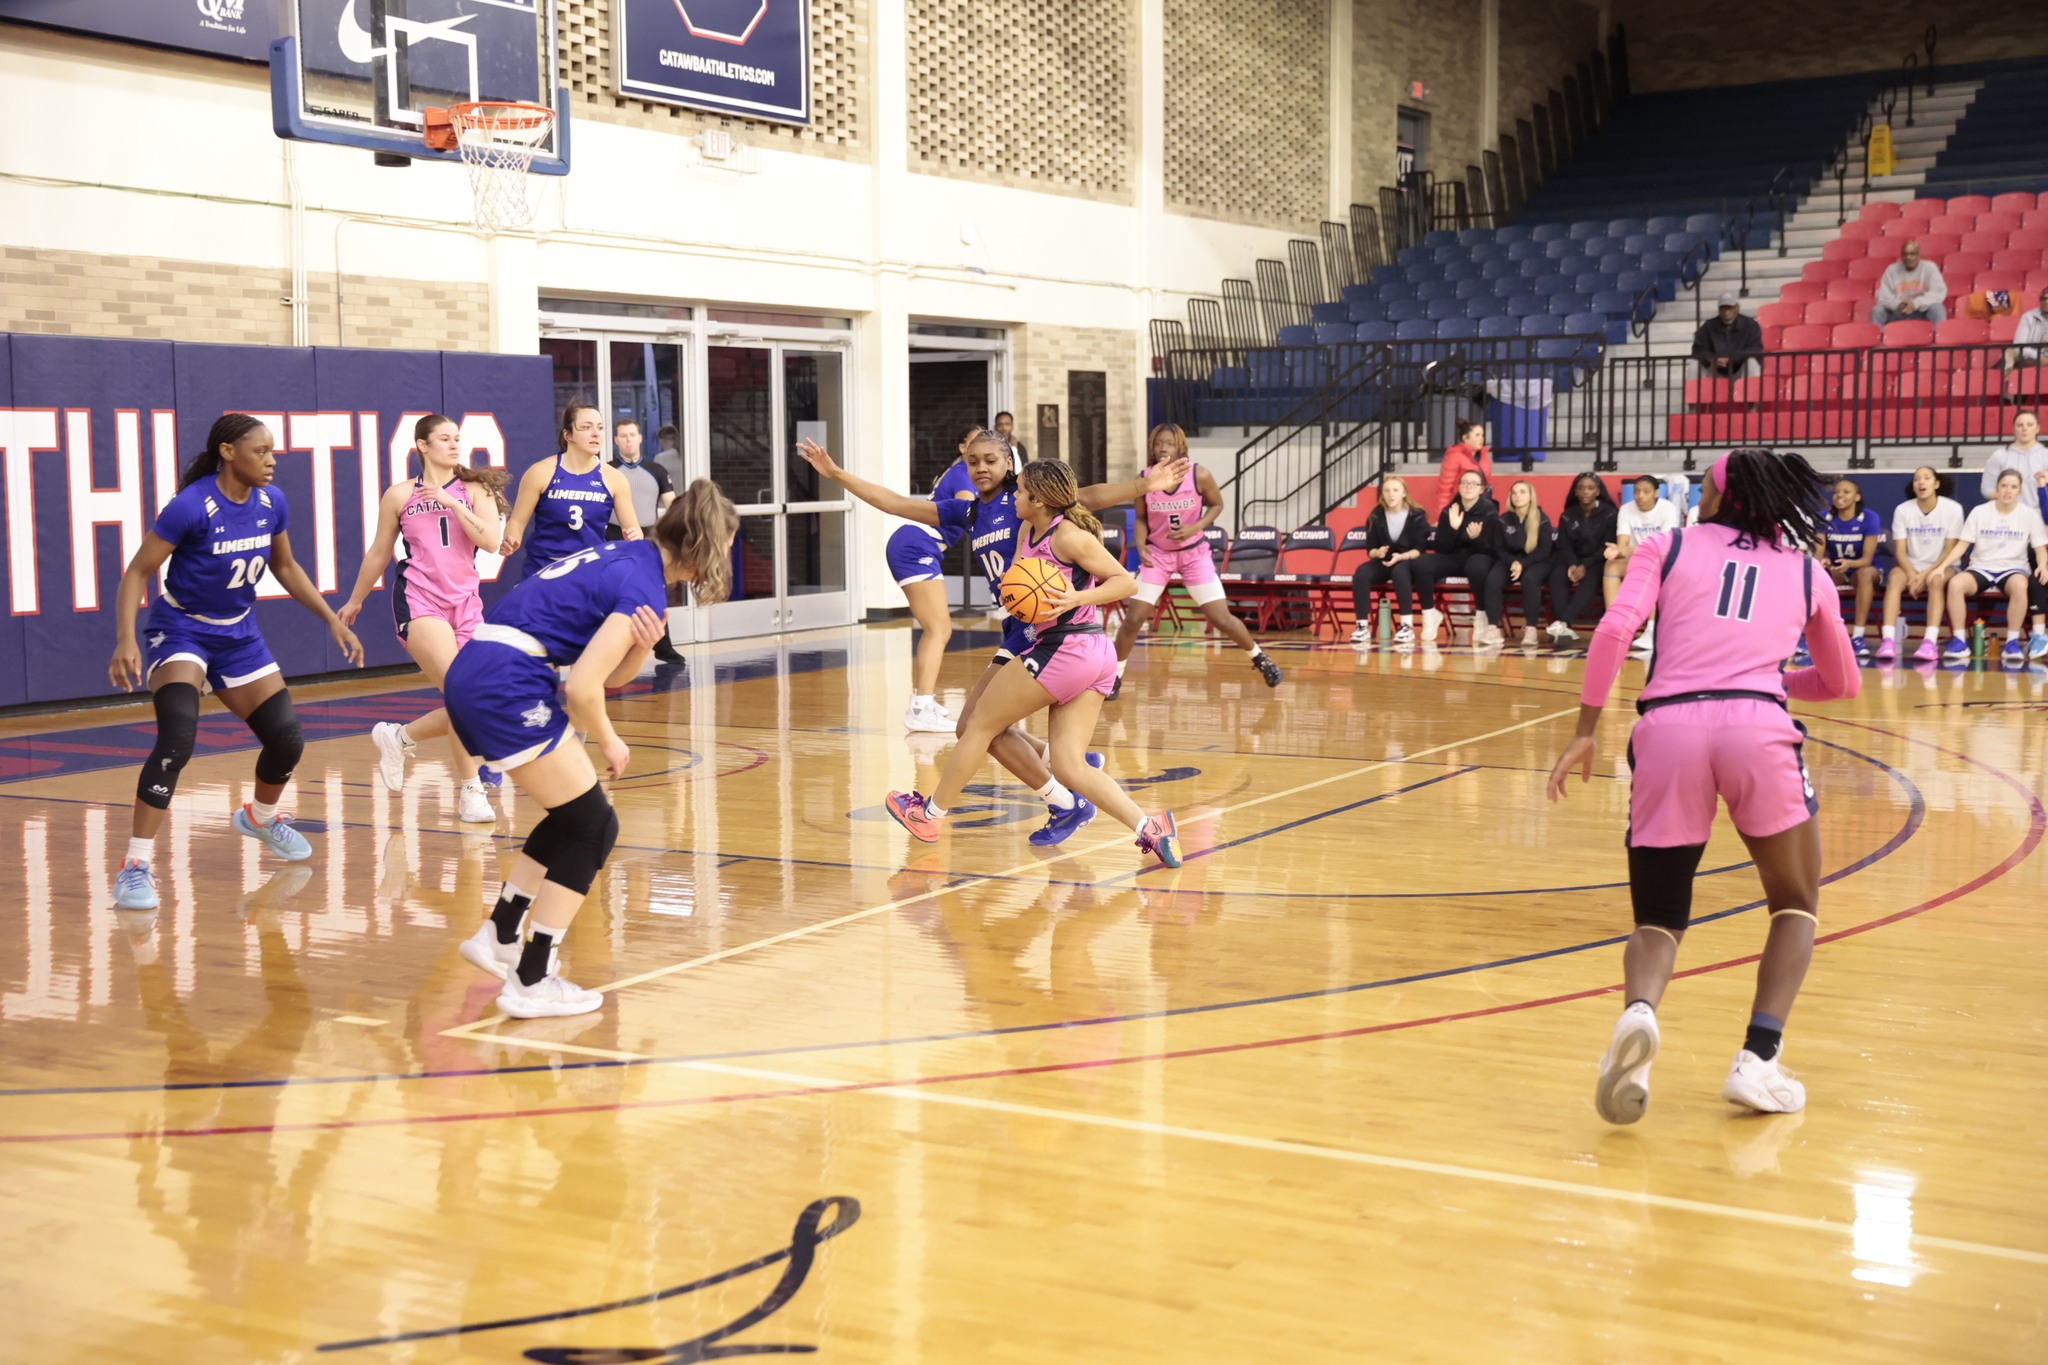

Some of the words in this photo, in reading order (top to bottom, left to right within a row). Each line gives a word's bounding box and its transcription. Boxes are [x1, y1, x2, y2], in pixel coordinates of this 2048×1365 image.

[219, 7, 243, 20] BANK
[659, 49, 775, 87] CATAWBAATHLETICS.COM
[547, 489, 608, 503] LIMESTONE
[1150, 499, 1195, 512] CATAWBA
[567, 504, 584, 531] 3
[1168, 513, 1182, 532] 5
[437, 515, 450, 548] 1
[1239, 530, 1276, 541] CATAWBA
[1292, 530, 1329, 541] CATAWBA
[1834, 543, 1856, 558] 14
[226, 555, 265, 590] 20
[979, 549, 1005, 582] 10
[1714, 559, 1760, 623] 11
